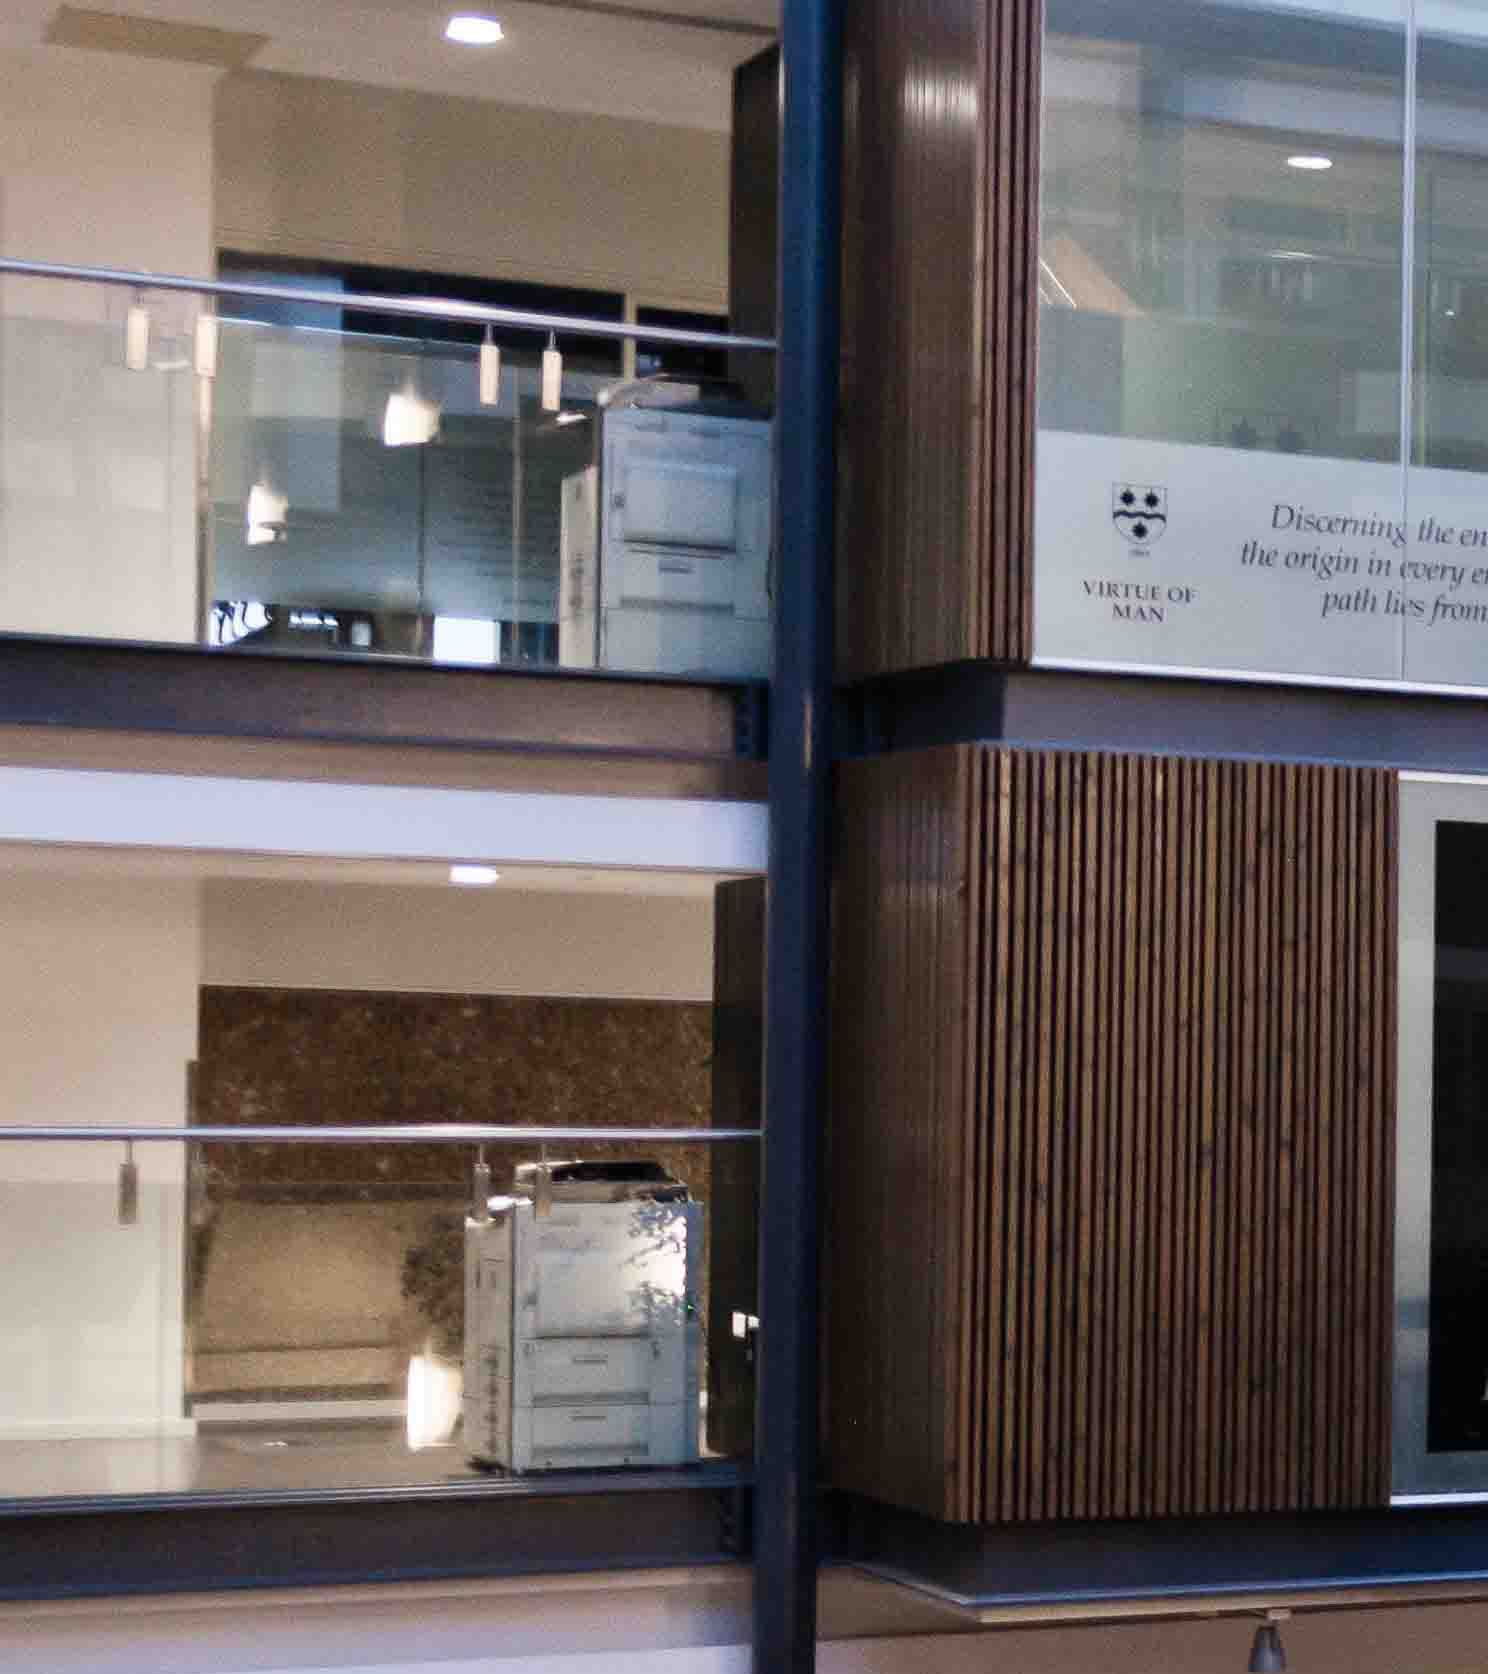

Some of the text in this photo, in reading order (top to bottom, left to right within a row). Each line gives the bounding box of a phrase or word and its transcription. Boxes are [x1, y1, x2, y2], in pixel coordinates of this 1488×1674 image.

[1271, 503, 1408, 547] Discerning
[1417, 517, 1453, 544] the
[1240, 540, 1279, 567] the
[1284, 548, 1359, 580] origin
[1366, 551, 1392, 577] in
[1398, 558, 1465, 585] every
[1082, 580, 1197, 603] VIRTUE OF
[1319, 588, 1377, 617] path
[1384, 589, 1426, 618] lies
[1428, 594, 1488, 627] from
[1112, 603, 1166, 623] MAN
